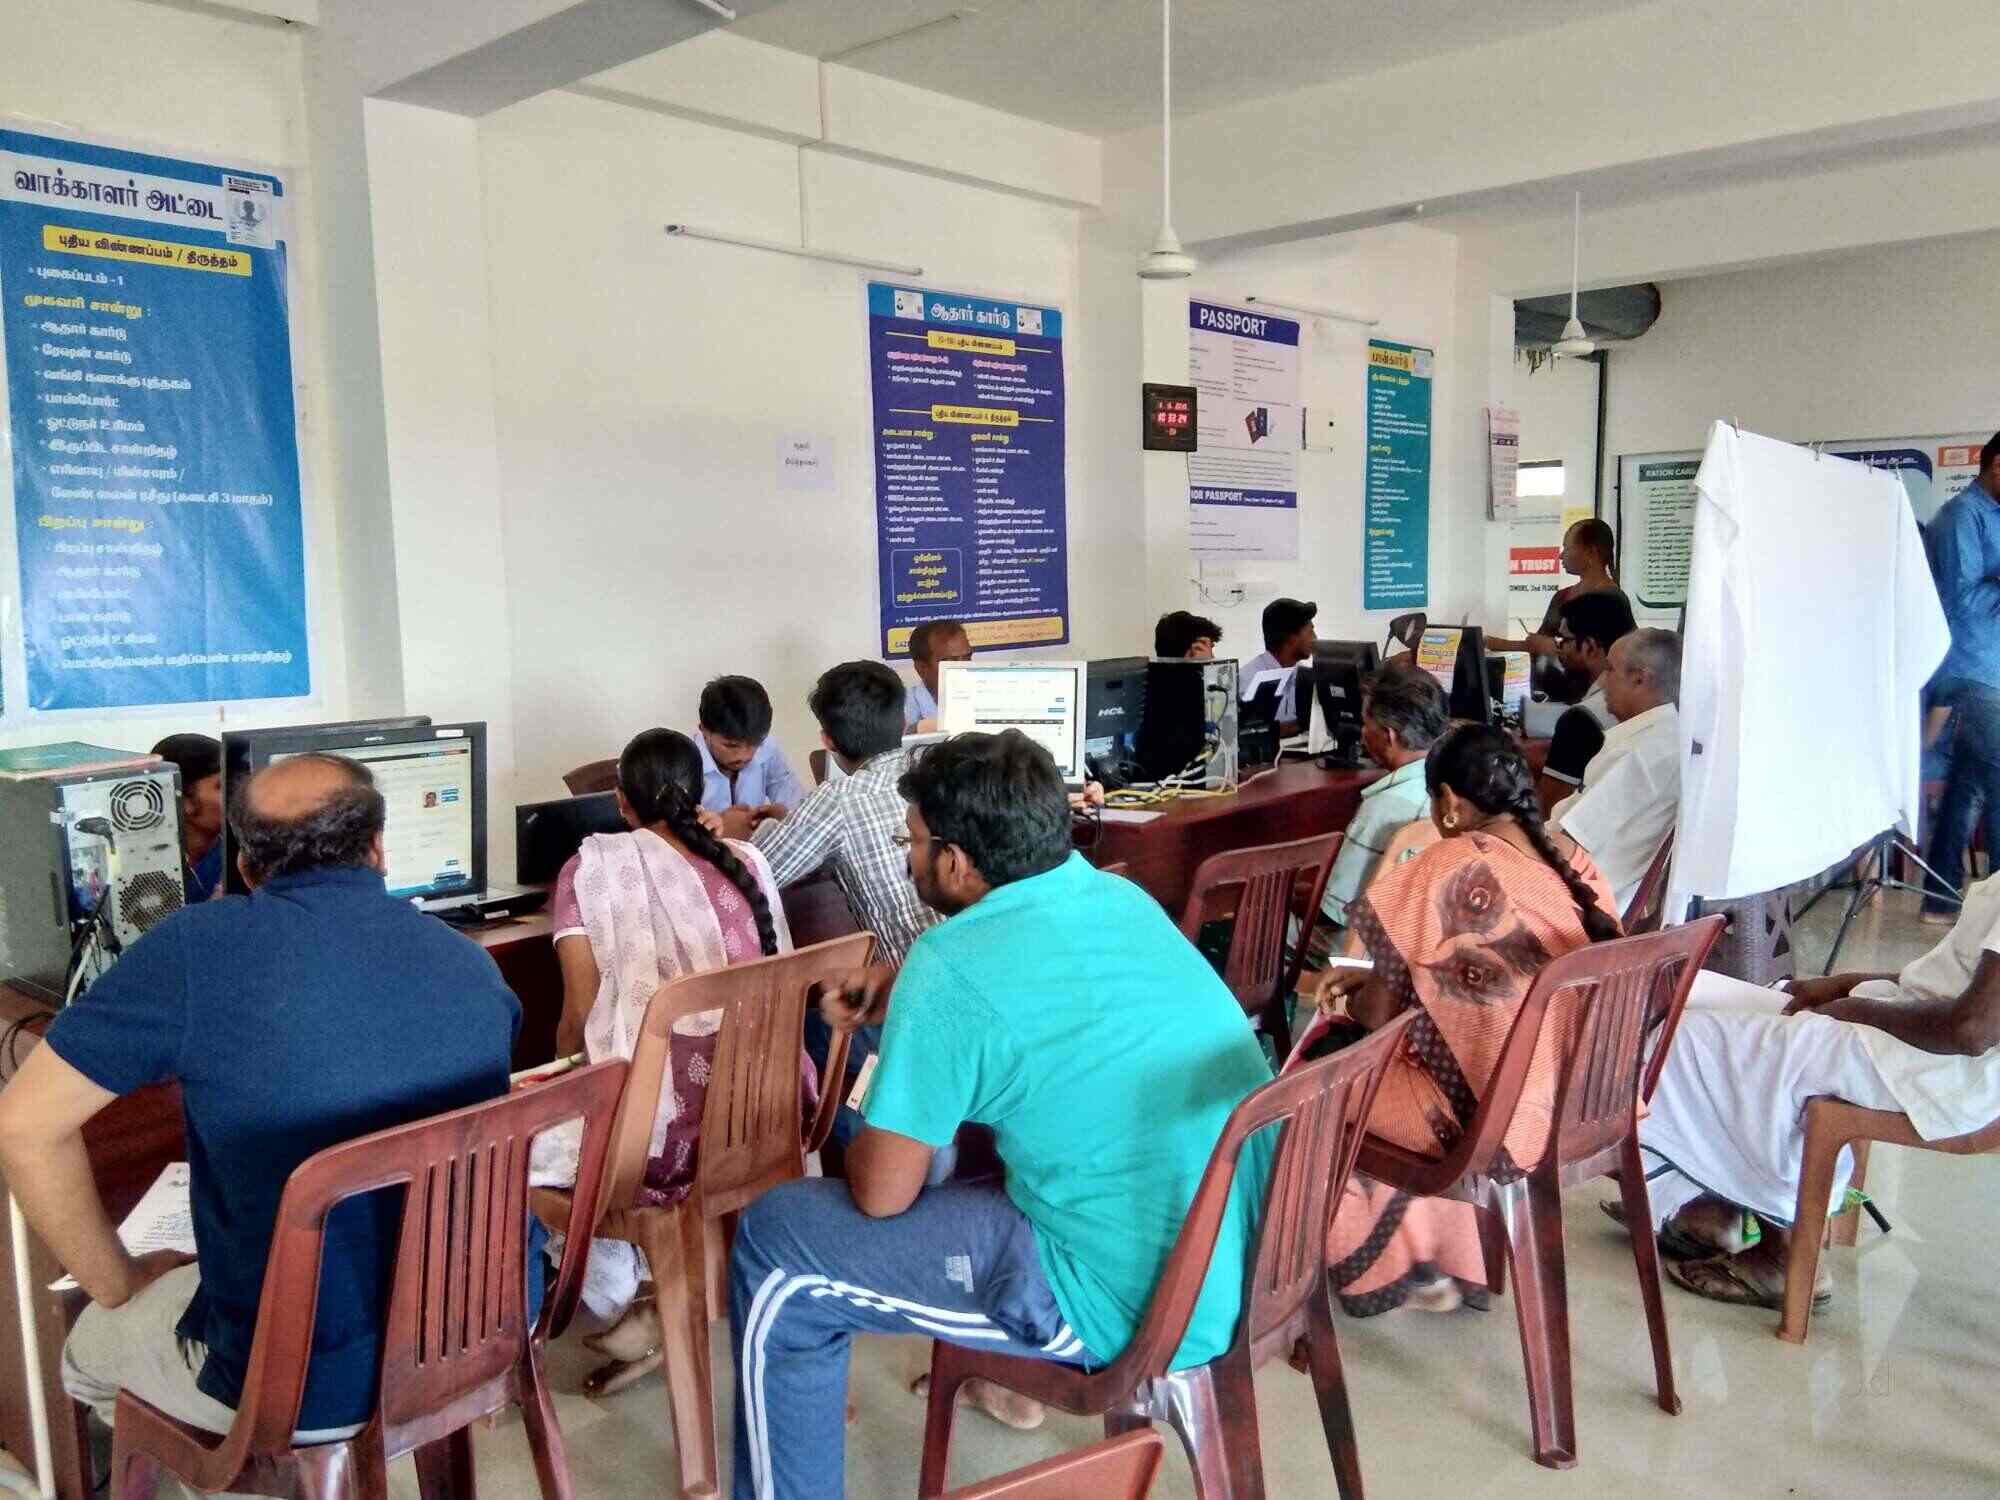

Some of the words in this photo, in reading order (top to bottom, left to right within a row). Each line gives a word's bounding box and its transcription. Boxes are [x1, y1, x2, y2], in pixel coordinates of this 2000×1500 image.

[14, 167, 139, 209] வாக்காளர்
[145, 188, 223, 221] அட்டை
[58, 233, 90, 250] புதிய
[94, 237, 173, 259] விண்ணப்பம்
[186, 252, 238, 269] திருத்தம்
[931, 302, 974, 324] ஆதார்
[975, 307, 1010, 329] கார்டு
[1200, 307, 1267, 337] PASSPORT
[1205, 490, 1242, 502] PASSPORT
[1521, 559, 1555, 572] TRUST
[1098, 706, 1125, 718] HCL
